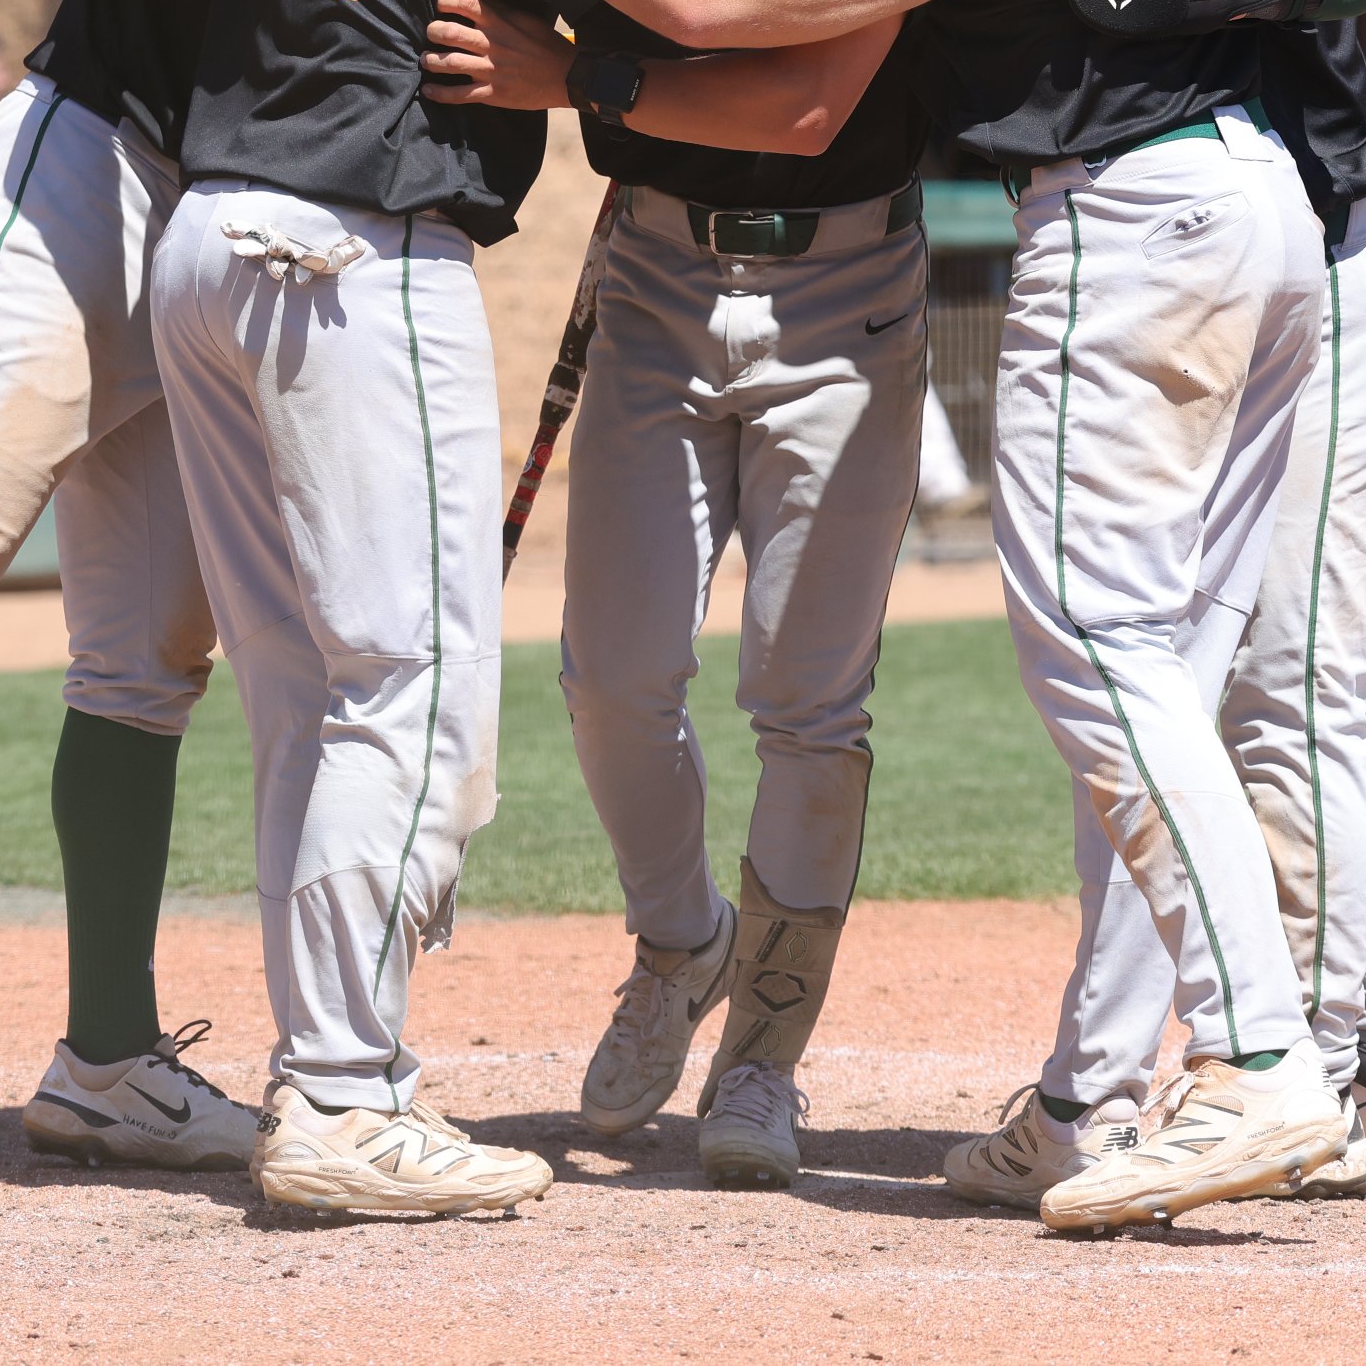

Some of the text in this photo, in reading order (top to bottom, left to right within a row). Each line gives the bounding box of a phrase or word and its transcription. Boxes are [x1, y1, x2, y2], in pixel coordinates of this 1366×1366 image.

[123, 1114, 166, 1137] HAVE FUN
[318, 1166, 338, 1174] FRESH
